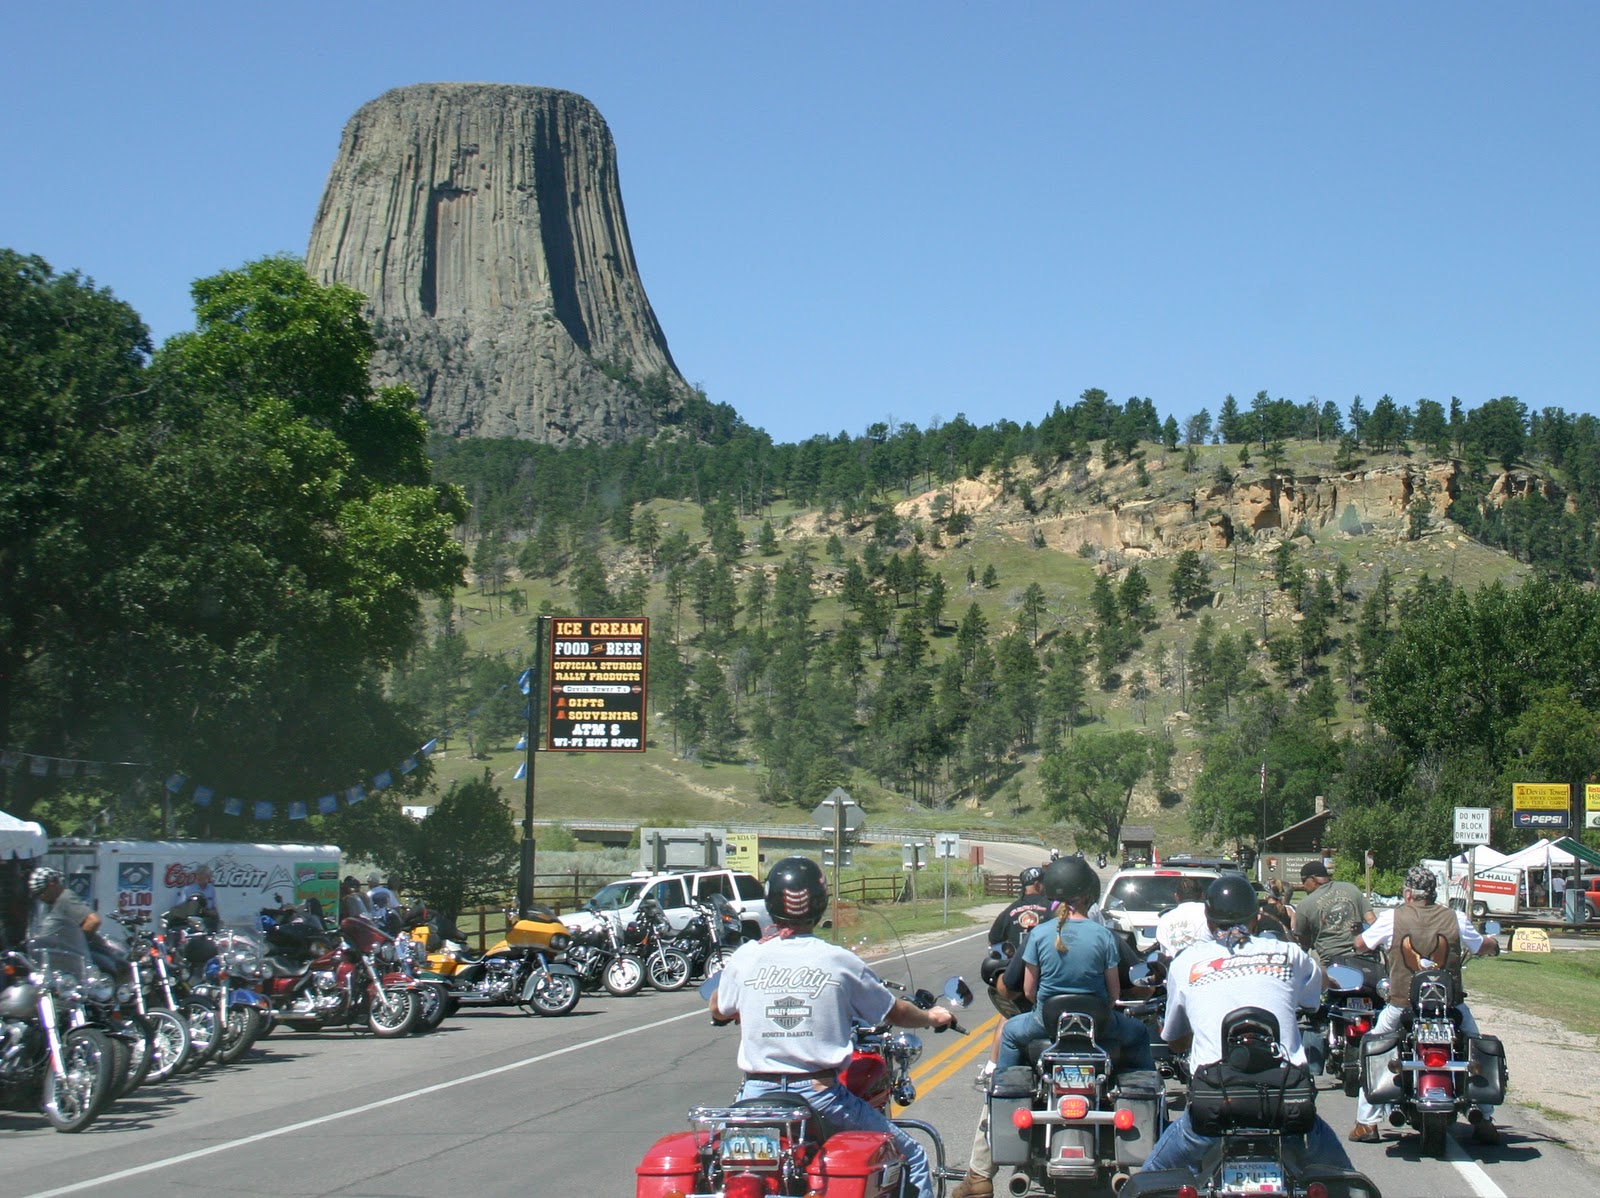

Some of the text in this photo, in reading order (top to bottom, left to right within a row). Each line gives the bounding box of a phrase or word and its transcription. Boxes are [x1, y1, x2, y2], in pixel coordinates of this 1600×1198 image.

[556, 622, 643, 635] ICE CREAM
[555, 642, 589, 655] FOOD
[606, 642, 642, 655] BEER
[569, 699, 604, 707] GIFTS
[568, 712, 638, 720] SOUVENIRS
[572, 724, 620, 736] ATM &
[554, 738, 638, 747] WI-FI HOT SPOT
[214, 868, 268, 888] LIGHT
[1478, 873, 1513, 881] U-HAUL
[1520, 942, 1548, 951] CREAM
[744, 965, 840, 999] Hill City
